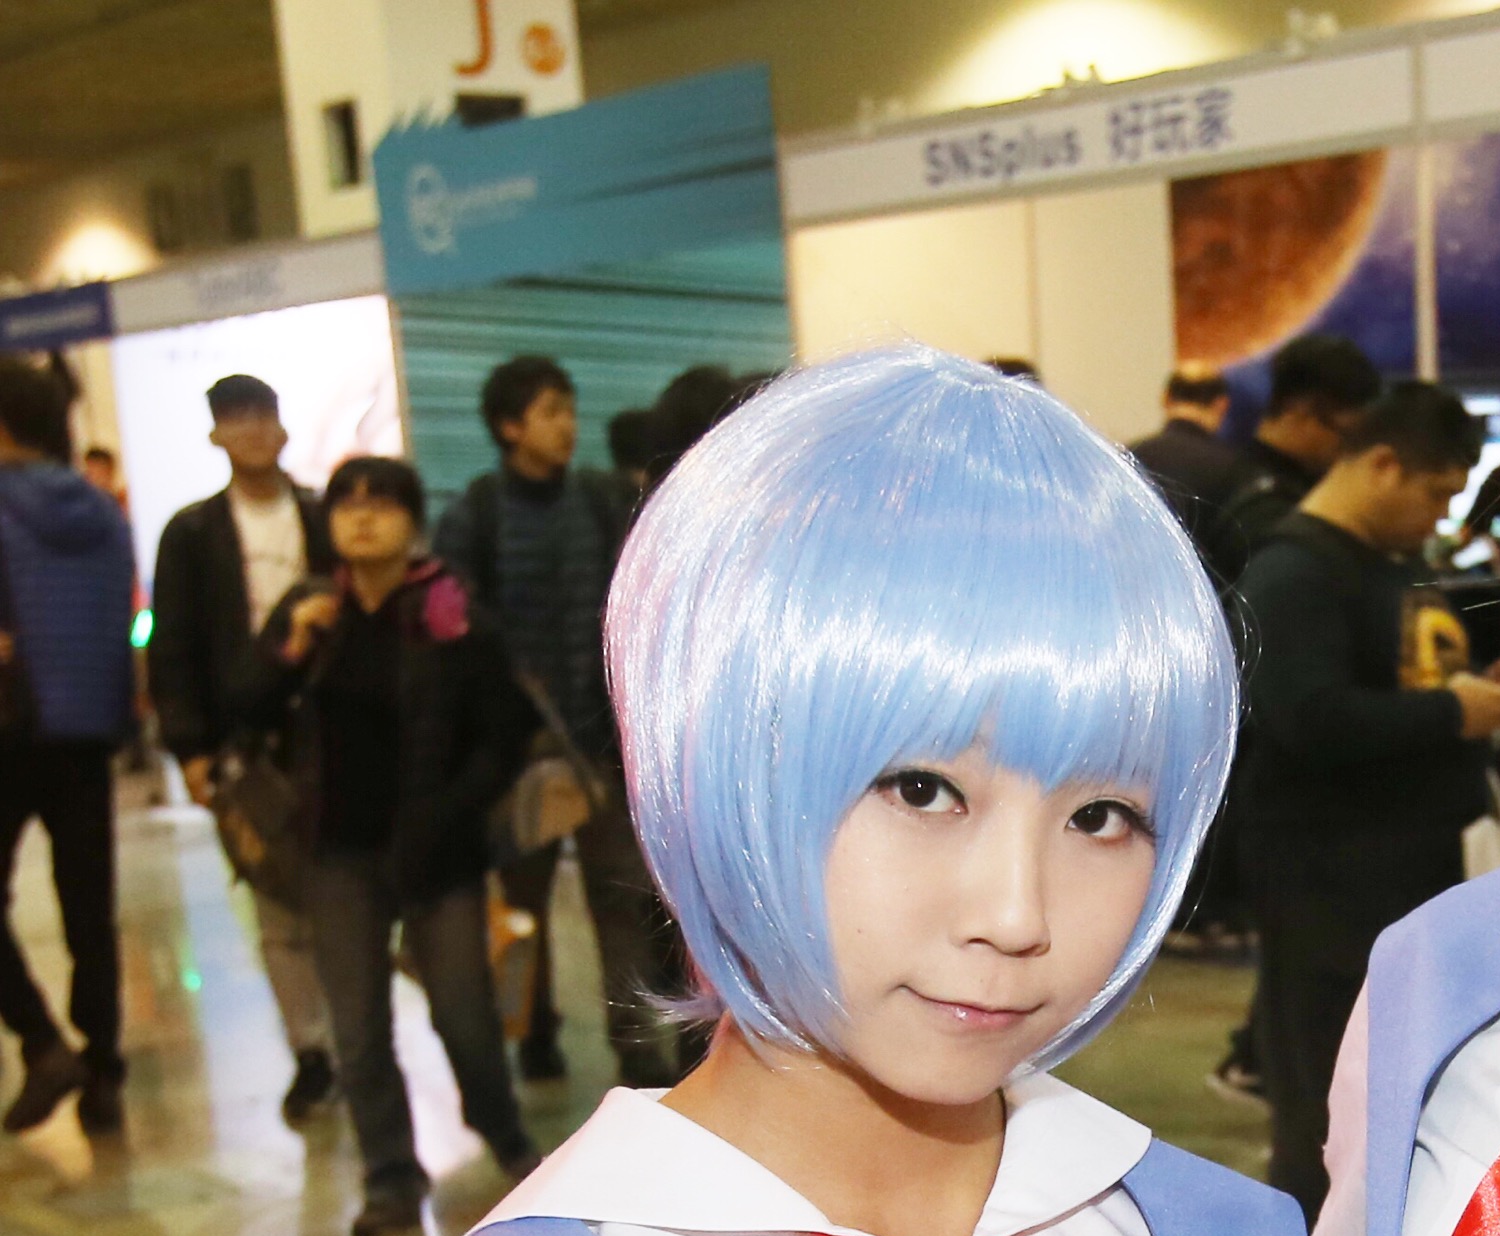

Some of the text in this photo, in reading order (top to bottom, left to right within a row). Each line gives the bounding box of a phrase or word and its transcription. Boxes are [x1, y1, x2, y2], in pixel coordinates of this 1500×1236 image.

[925, 88, 1232, 186] SNSplus 好玩家
